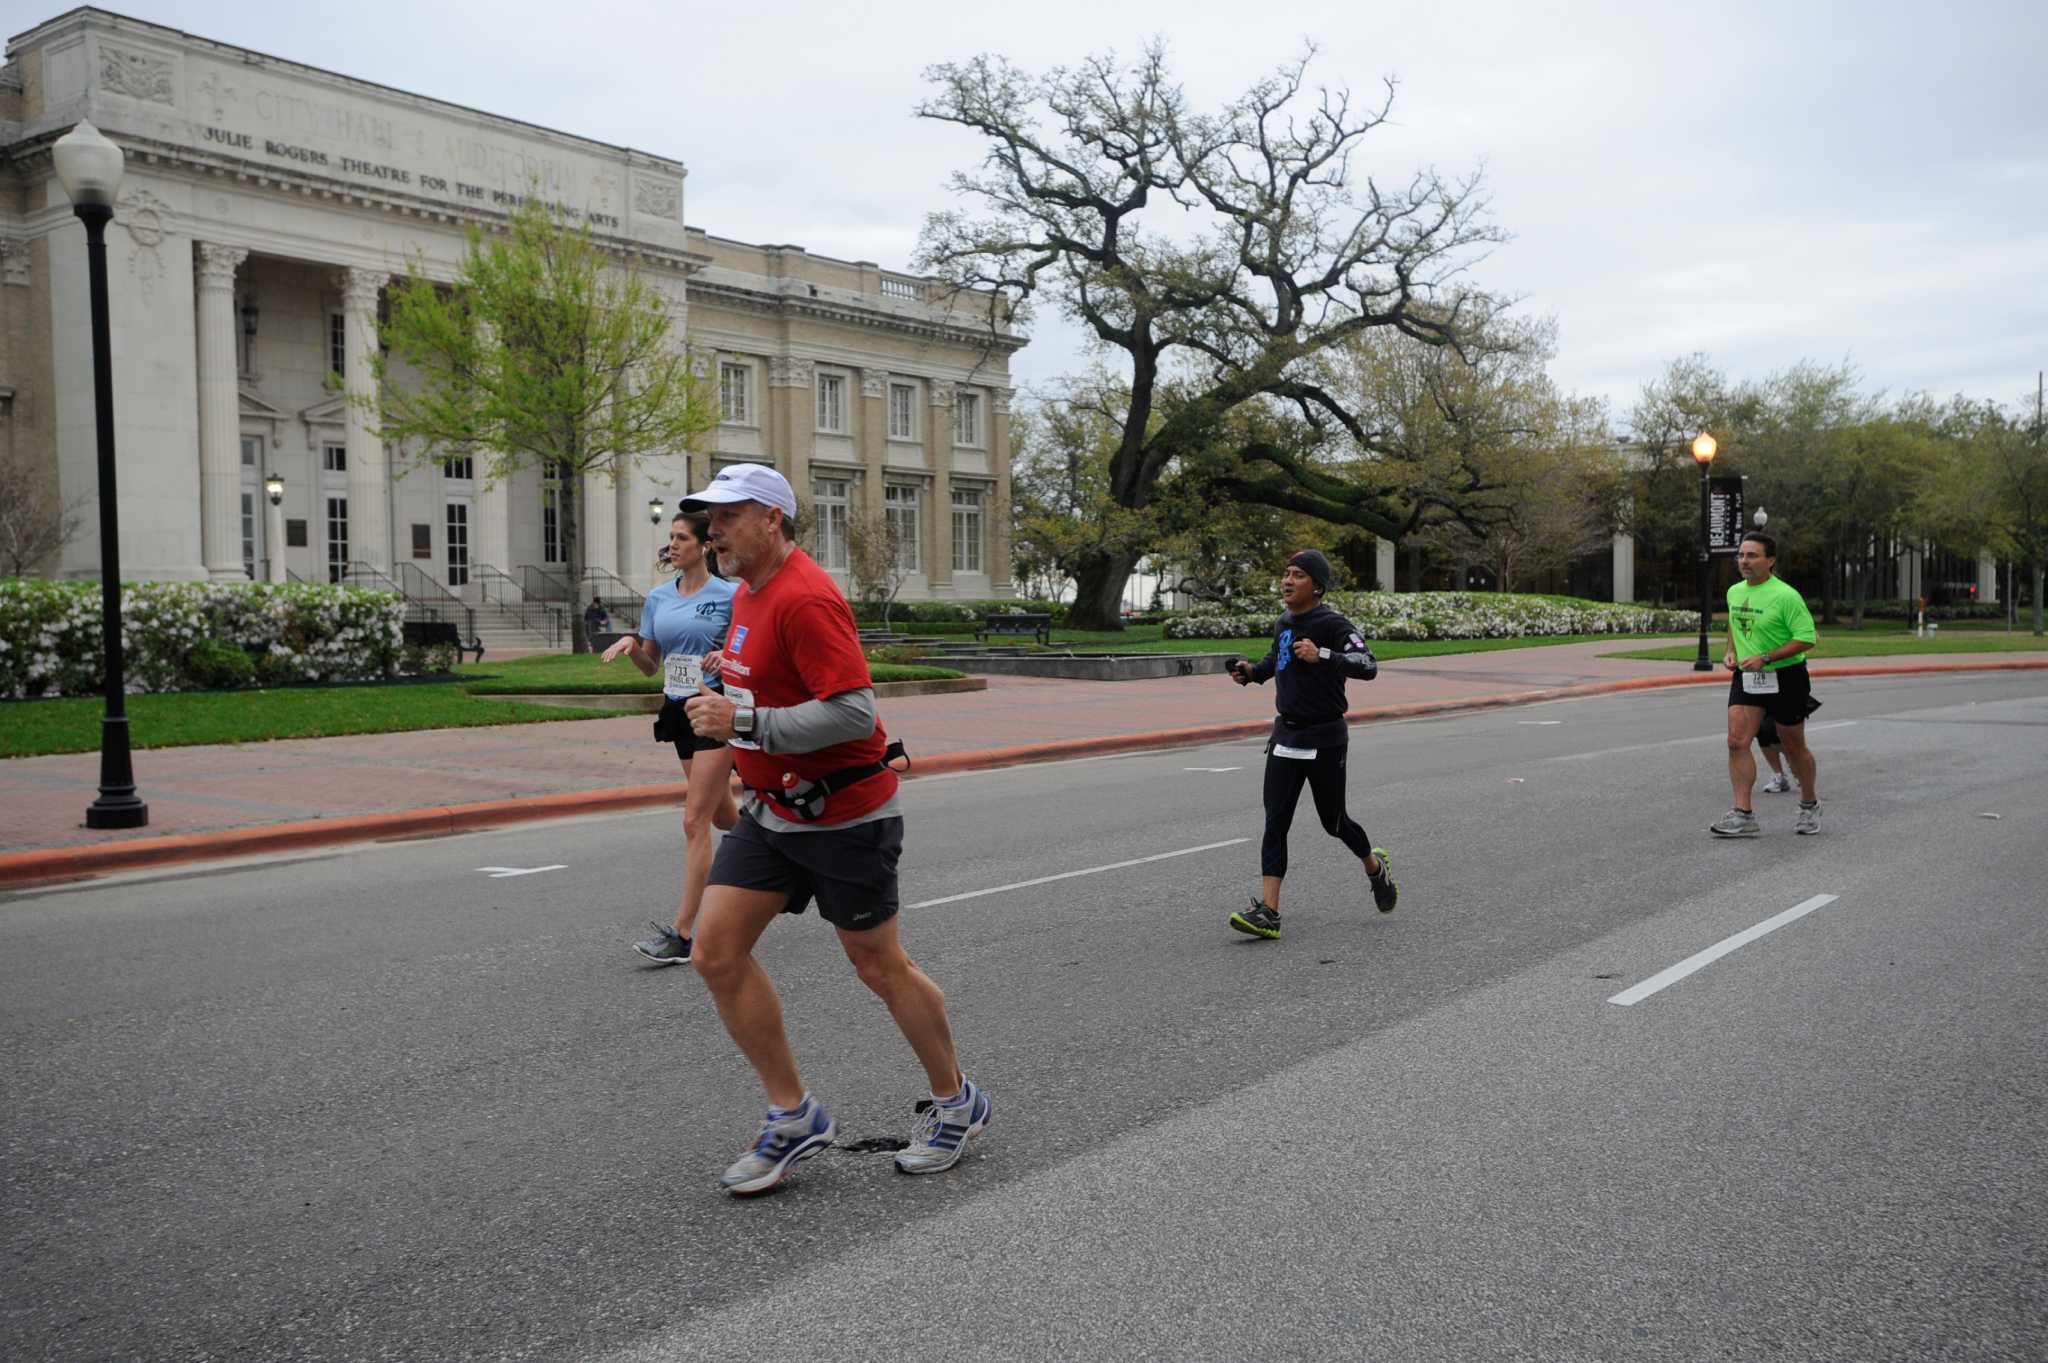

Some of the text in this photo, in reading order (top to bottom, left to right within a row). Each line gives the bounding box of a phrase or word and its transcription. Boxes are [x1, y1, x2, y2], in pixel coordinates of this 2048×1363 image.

[203, 127, 253, 149] JULIE
[265, 140, 328, 166] ROGERS
[340, 157, 411, 184] THEATRE
[420, 174, 448, 192] FOR
[456, 182, 484, 200] THE
[588, 212, 619, 229] ARTS
[1710, 492, 1725, 546] BEAUMONT
[674, 665, 688, 677] 733
